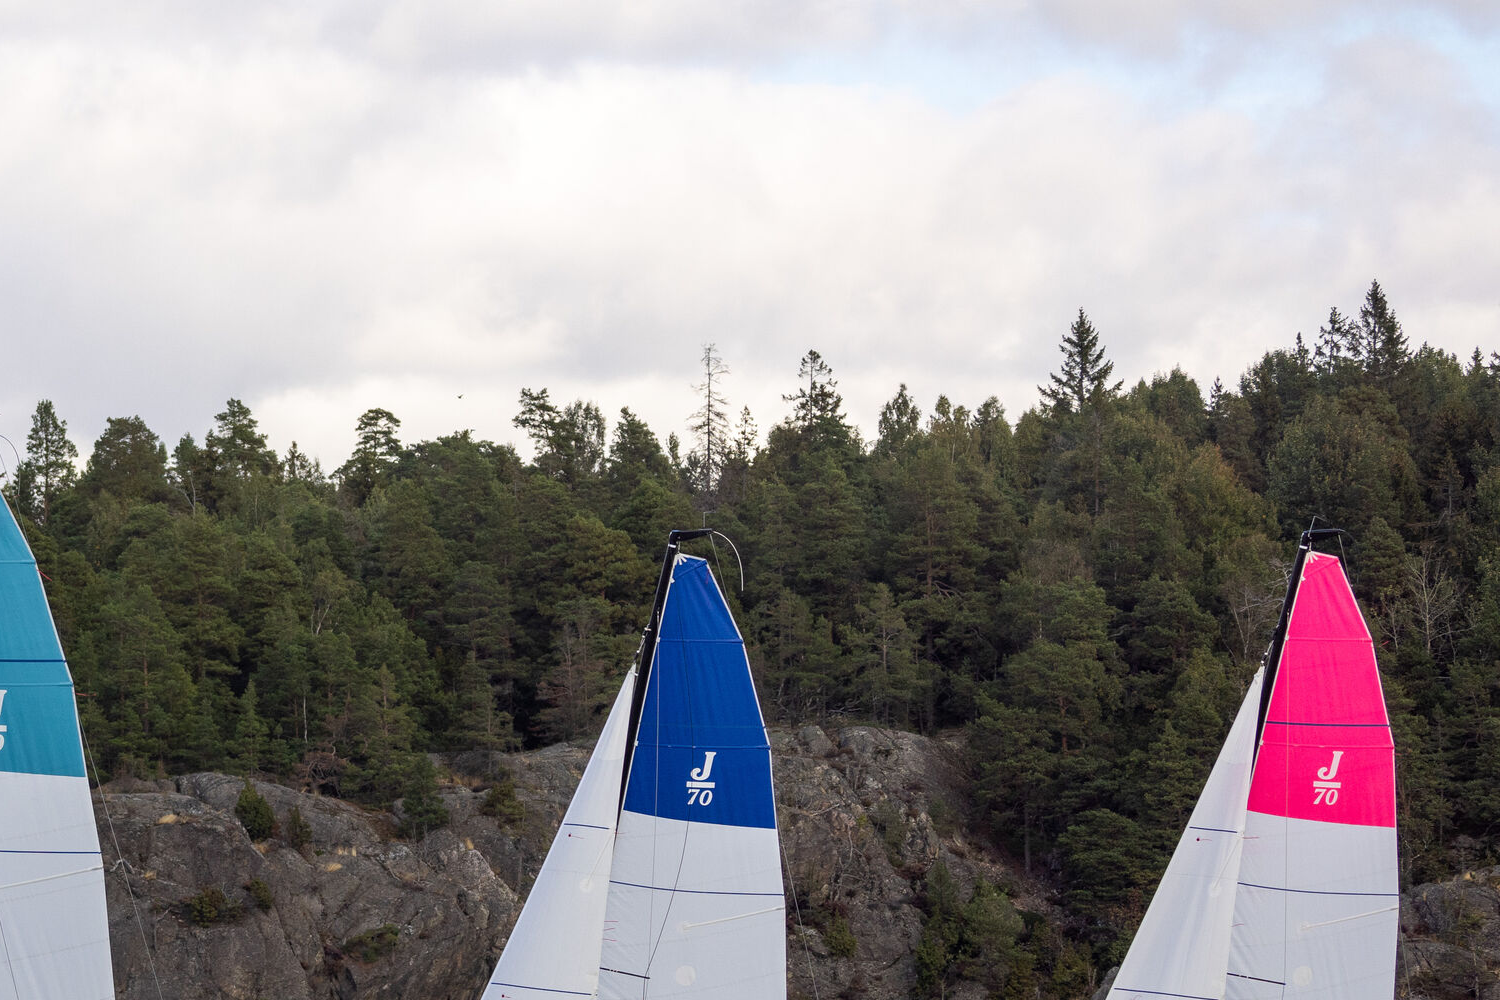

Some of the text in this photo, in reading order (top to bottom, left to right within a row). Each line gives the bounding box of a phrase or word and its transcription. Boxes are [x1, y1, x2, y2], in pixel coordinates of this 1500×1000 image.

[690, 751, 717, 781] J
[1317, 751, 1344, 780] J
[687, 788, 713, 806] 70
[1313, 788, 1338, 805] 70
